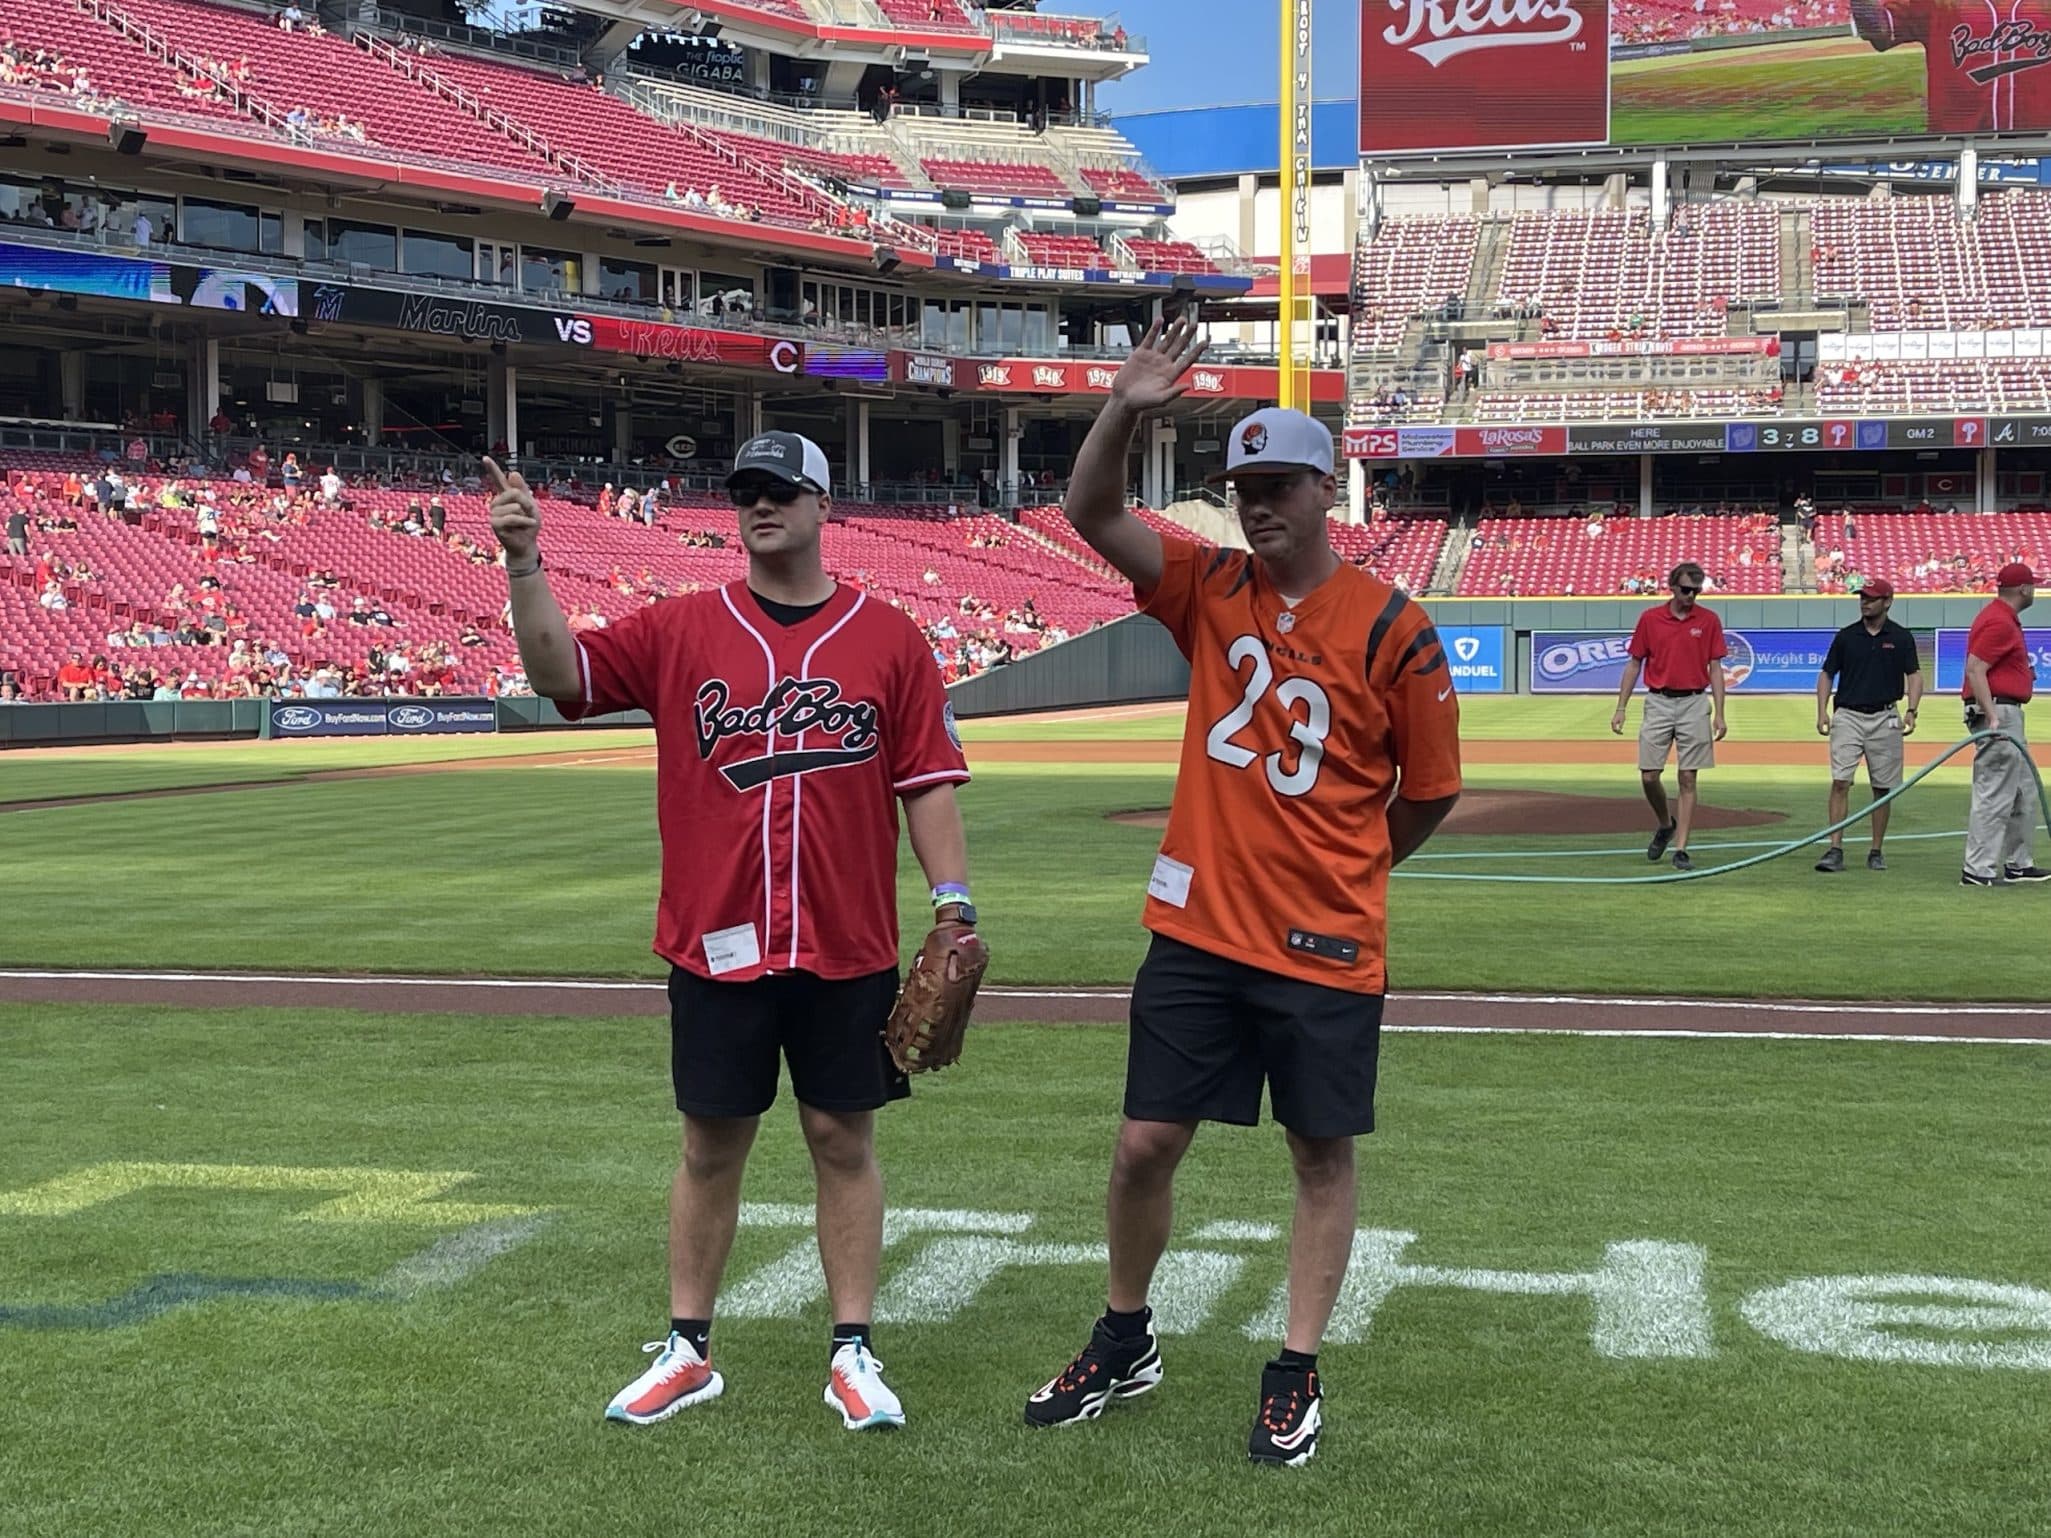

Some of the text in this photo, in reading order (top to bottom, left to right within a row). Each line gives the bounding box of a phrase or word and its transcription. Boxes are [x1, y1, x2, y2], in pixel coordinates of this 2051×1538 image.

[1298, 0, 1309, 57] ROOT
[1569, 42, 1586, 51] TM
[1917, 165, 2001, 181] CENER
[1009, 266, 1085, 281] TRIPLE PLAY SUITES
[398, 292, 522, 342] Marlins
[553, 317, 593, 345] VS
[770, 341, 798, 373] C
[908, 361, 952, 385] CHAMPIONS
[1088, 369, 1113, 386] 1975
[1194, 373, 1218, 390] 1990
[1630, 428, 1660, 438] HERE
[1763, 428, 1779, 444] 3
[1801, 428, 1819, 444] 8
[1344, 434, 1397, 453] MPS
[1568, 438, 1724, 451] BALL PARK EVEN MORE ENJOYABLE
[1756, 651, 1803, 668] Wright
[281, 708, 312, 726] Ford
[396, 708, 427, 725] Ford
[1206, 633, 1333, 798] 23
